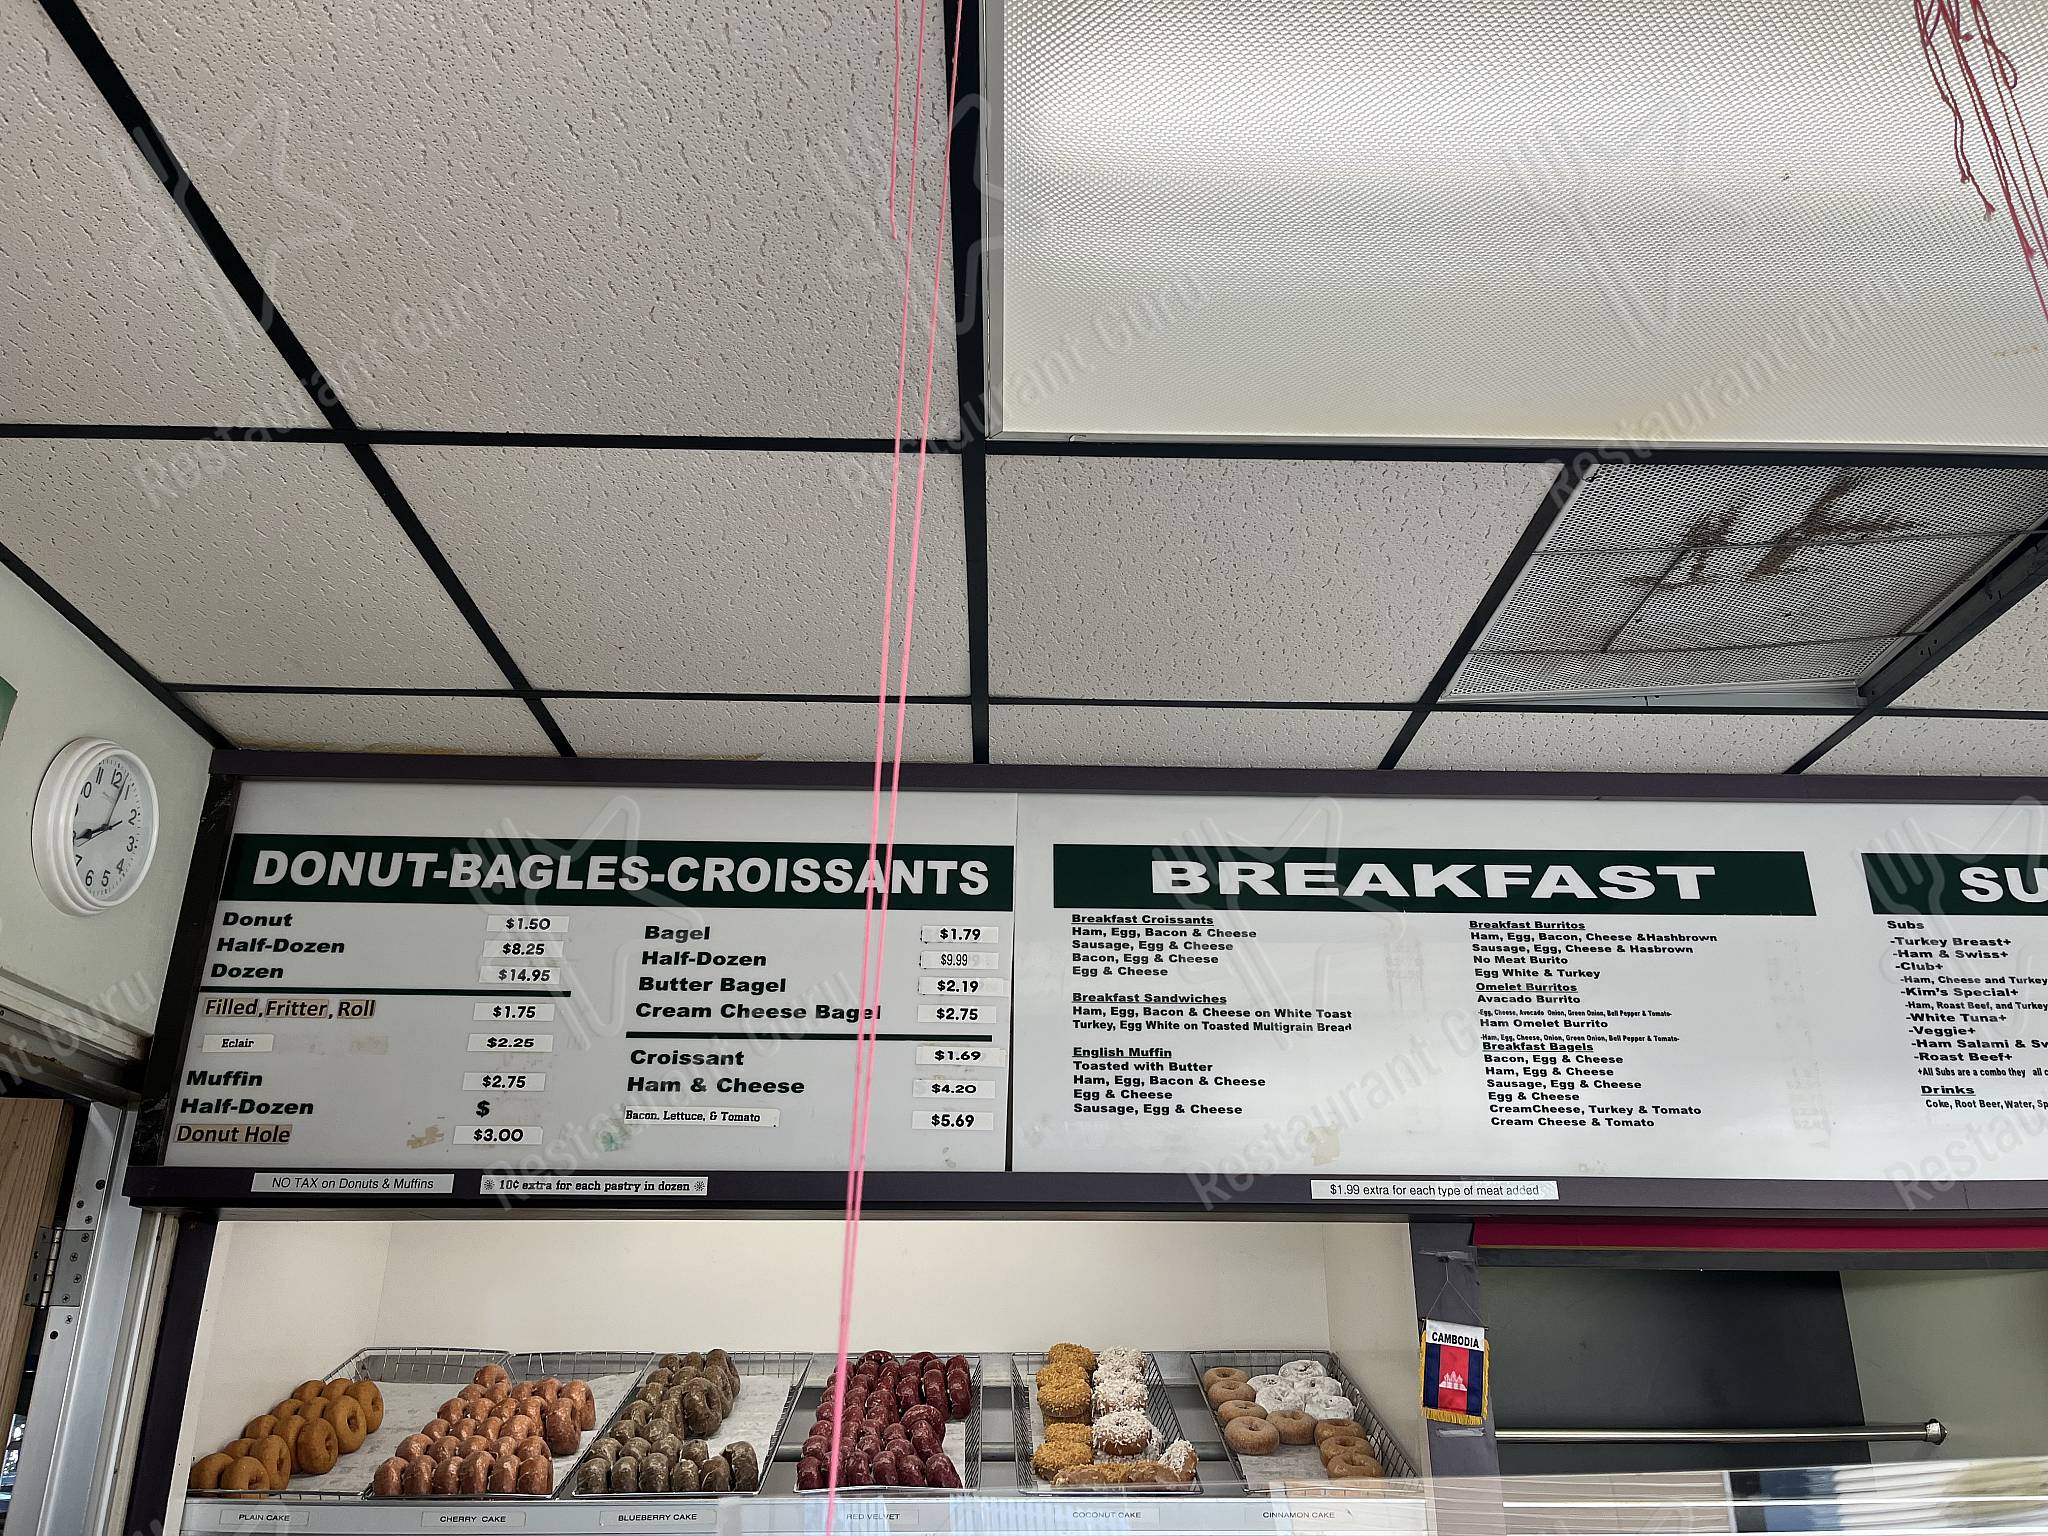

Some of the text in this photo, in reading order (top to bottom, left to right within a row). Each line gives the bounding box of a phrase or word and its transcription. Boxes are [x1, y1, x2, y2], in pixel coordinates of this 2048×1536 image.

[253, 850, 989, 894] DONUT-BAGLES-CROISSANTS
[1152, 861, 1715, 899] BREAKFAST
[222, 912, 292, 926] Donut
[506, 918, 550, 930] $1.50
[1072, 914, 1213, 924] Breakfast Croissants
[1534, 921, 1584, 929] Burritos
[1887, 921, 1924, 929] Subs
[644, 925, 709, 943] Bagel
[940, 928, 980, 941] $1.79
[1072, 927, 1106, 937] Ham,
[1111, 928, 1140, 938] Egg,
[1145, 928, 1186, 936] Bacon
[1207, 929, 1256, 937] Cheese
[1470, 932, 1503, 941] Ham,
[1507, 932, 1534, 942] Egg,
[1538, 933, 1581, 941] Bacon,
[216, 938, 344, 952] Half-Dozen
[1890, 937, 1947, 947] -Turkey
[502, 942, 544, 955] $8.25
[1893, 949, 2008, 958] -Ham & Swiss+
[642, 951, 766, 965] Half-Dozen
[941, 953, 967, 966] $9.99
[1530, 956, 1568, 964] Burito
[210, 964, 283, 977] Dozen
[1895, 962, 1943, 970] -Club+
[498, 968, 550, 983] $14.95
[1900, 976, 1934, 984] -Ham,
[2008, 976, 2047, 985] Turkey
[638, 977, 785, 995] Butter Bagel
[937, 979, 978, 992] $2.19
[1526, 983, 1576, 991] Burritos
[1073, 993, 1226, 1002] Breakfast Sandwiches
[1901, 988, 2018, 998] -Kim's Special+
[337, 1000, 375, 1018] Roll
[492, 1005, 535, 1018] $1.75
[636, 1003, 880, 1022] Cream Cheese Bagel
[936, 1007, 978, 1020] $2.75
[1073, 1006, 1105, 1016] Ham,
[1110, 1007, 1138, 1017] Egg,
[1143, 1007, 1183, 1016] Bacon
[1188, 1007, 1197, 1016] &
[1202, 1008, 1250, 1016] Cheese
[1274, 1008, 1311, 1017] White
[1316, 1009, 1351, 1018] Toast
[1513, 1019, 1559, 1027] Omelet
[1563, 1019, 1608, 1027] Burrito
[1906, 1013, 2006, 1022] -White Tuna+
[1072, 1020, 1115, 1030] Turkey,
[1120, 1020, 1141, 1031] Egg
[1145, 1020, 1179, 1029] White
[1201, 1021, 1249, 1030] Toasted
[1253, 1022, 1312, 1033] Multigrain
[1908, 1026, 1975, 1036] -Veggie+
[221, 1038, 254, 1047] Eclair
[486, 1037, 534, 1048] $2.25
[1482, 1042, 1593, 1051] Breakfast Bagels
[934, 1049, 980, 1060] $1.69
[1072, 1047, 1171, 1056] English Muffin
[1914, 1052, 2012, 1061] -Roast Beef+
[630, 1051, 744, 1065] Croissant
[1073, 1061, 1212, 1071] Toasted with Butter
[186, 1070, 262, 1085] Muffin
[482, 1075, 526, 1088] $2.75
[627, 1077, 804, 1092] Ham & Cheese
[931, 1084, 976, 1093] $4.20
[1921, 1086, 1975, 1094] Drinks
[180, 1099, 313, 1114] Half-Dozen
[476, 1100, 489, 1117] $
[663, 1111, 706, 1122] Lettuce,
[721, 1112, 760, 1121] Tomato
[931, 1114, 974, 1127] $5.69
[176, 1126, 290, 1143] Donut Hole
[473, 1128, 523, 1141] $3.00
[272, 1177, 434, 1190] NO TAX on Donuts & Muffins
[522, 1181, 552, 1190] extra
[556, 1180, 572, 1190] for
[575, 1180, 600, 1190] each
[604, 1181, 640, 1192] pastry
[644, 1180, 655, 1191] in
[658, 1181, 690, 1191] dozen
[1330, 1184, 1538, 1196] $1.99 extra for each type of meat added
[1432, 1332, 1479, 1348] CAMBODIA
[238, 1512, 289, 1523] PLAIN CAKE
[439, 1513, 506, 1524] CHERRY CAKE
[618, 1513, 697, 1522] BLUEBERRY CAKE
[846, 1512, 900, 1521] RED VELVET
[1072, 1511, 1140, 1519] COCONUT CAKE
[1311, 1511, 1334, 1519] CAKE
